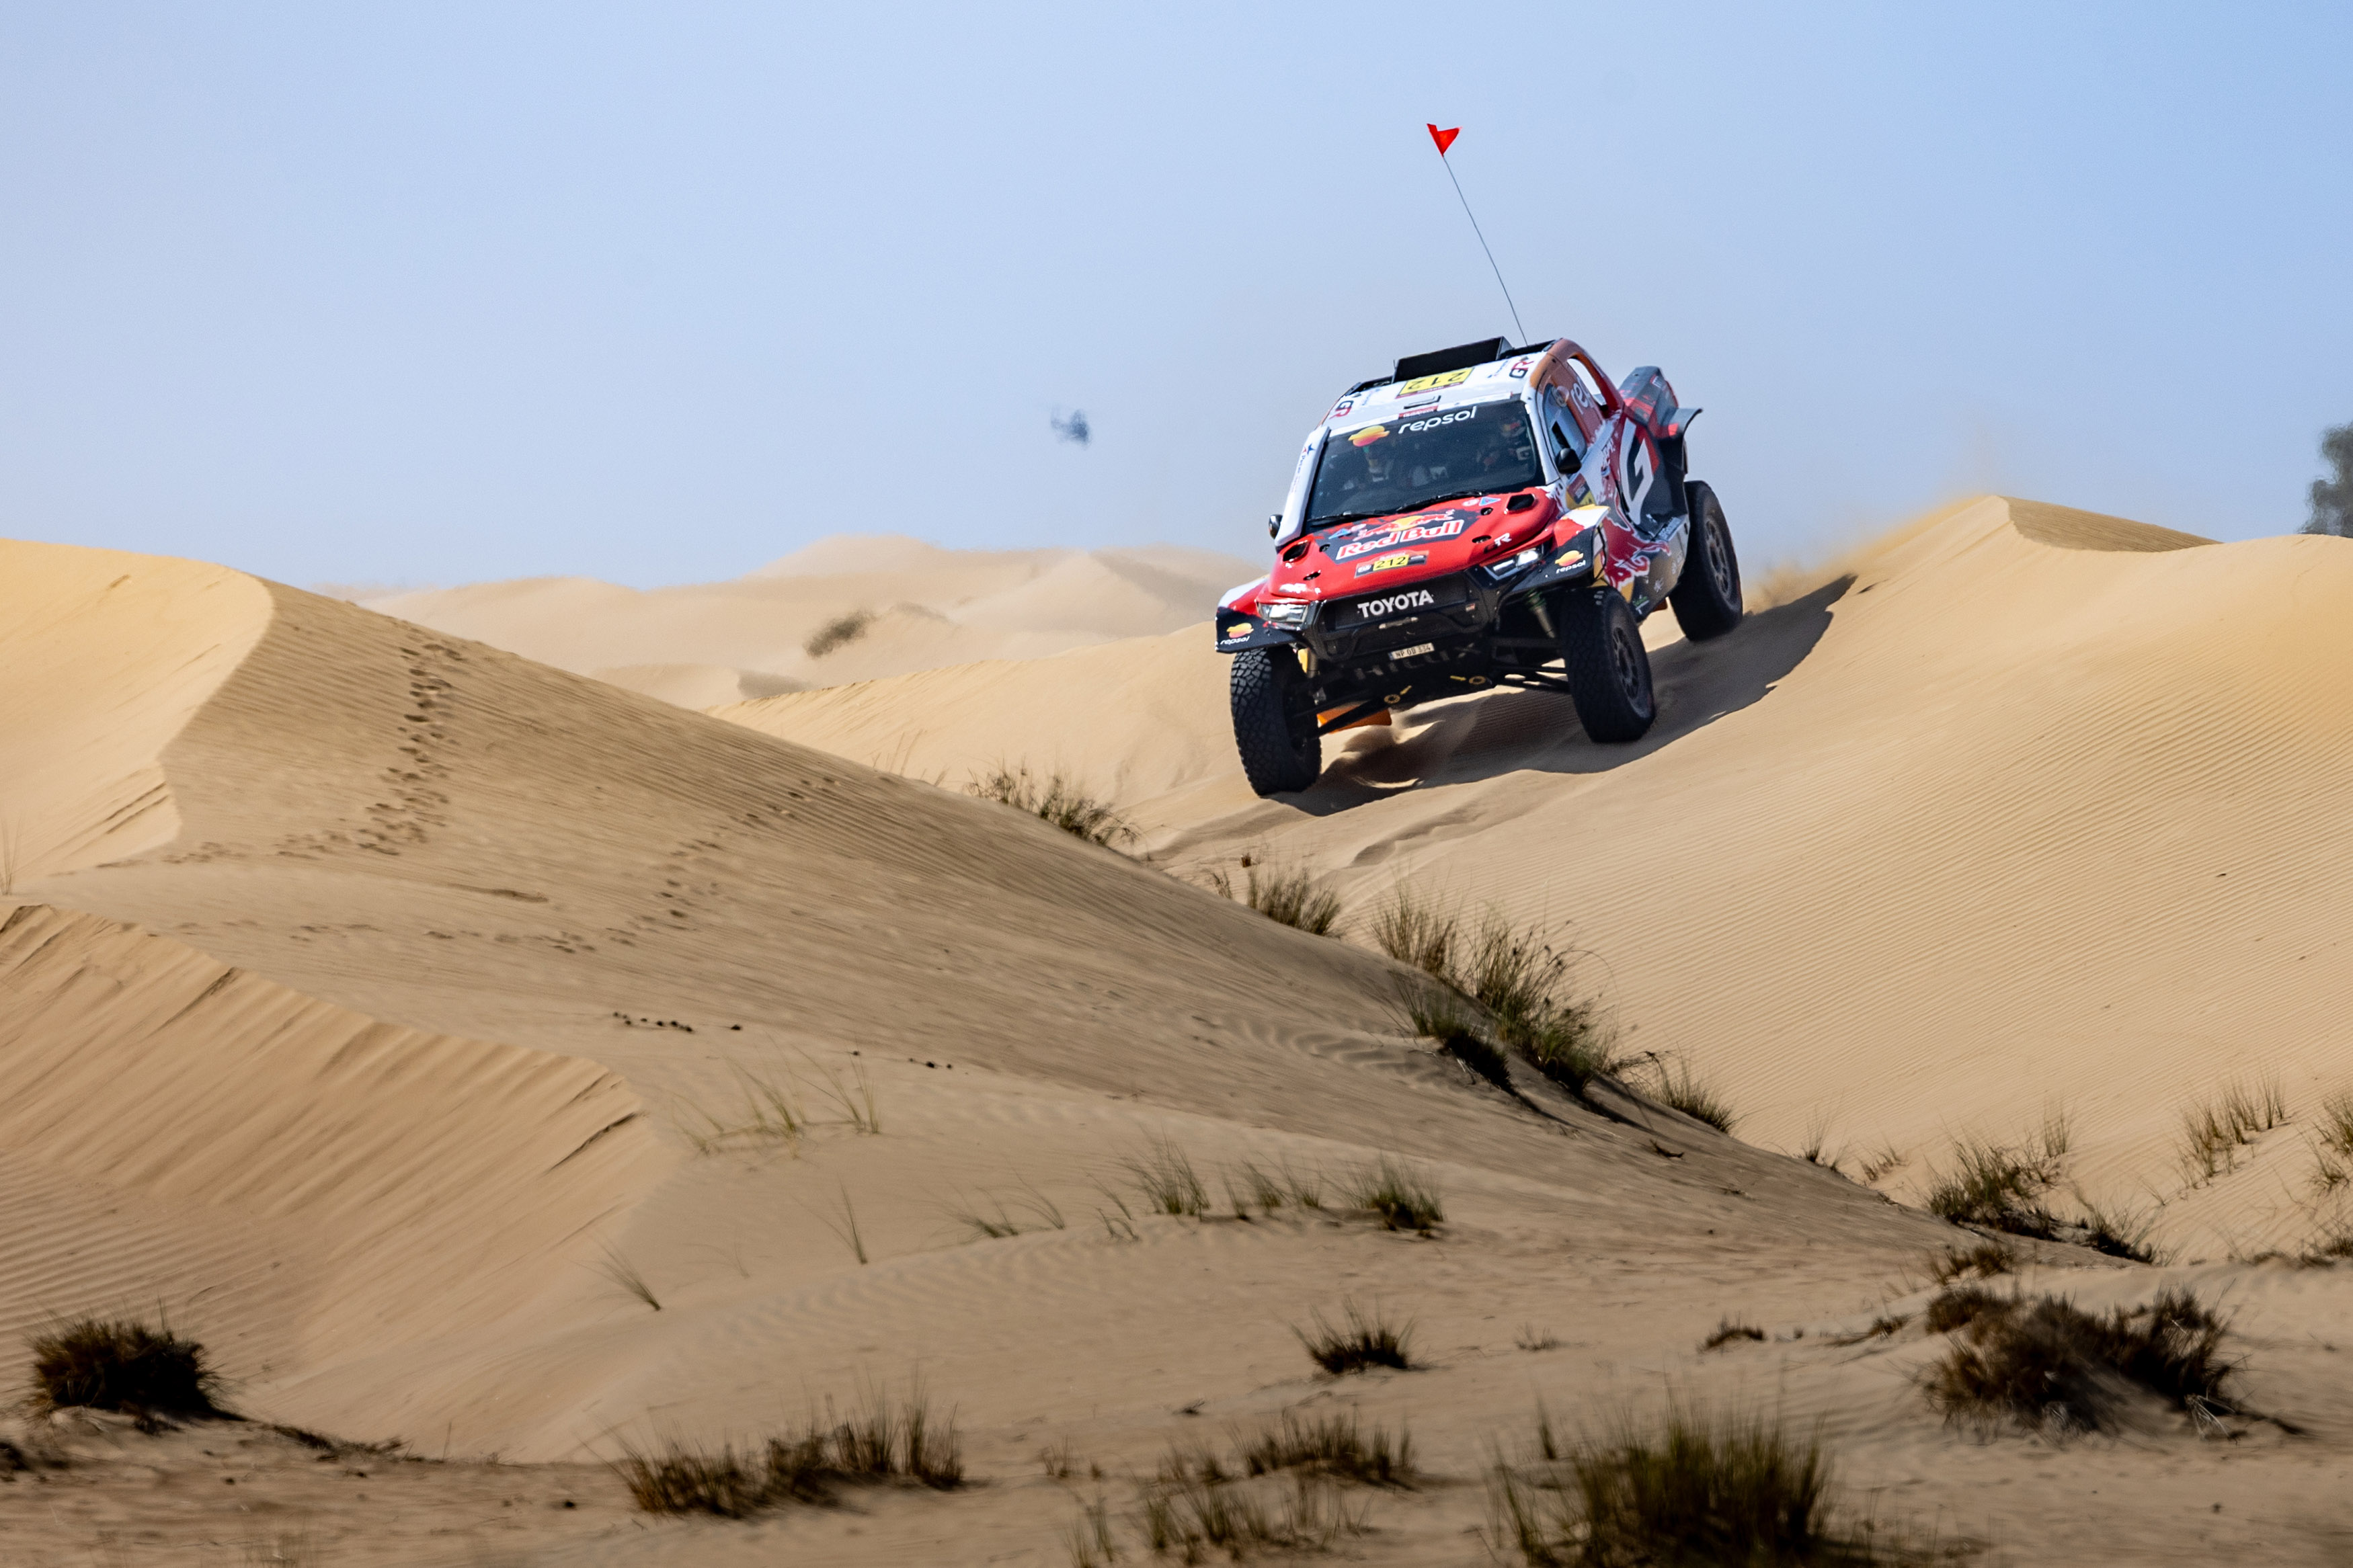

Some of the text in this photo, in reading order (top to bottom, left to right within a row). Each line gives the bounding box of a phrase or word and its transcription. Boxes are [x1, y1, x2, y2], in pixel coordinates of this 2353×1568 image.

[1407, 371, 1466, 390] 212
[1398, 406, 1477, 434] repsol
[1335, 520, 1465, 560] Red Bull
[1375, 556, 1406, 569] 212
[1556, 560, 1586, 574] repsol
[1357, 589, 1434, 618] TOYOTA
[1220, 636, 1250, 645] repsol
